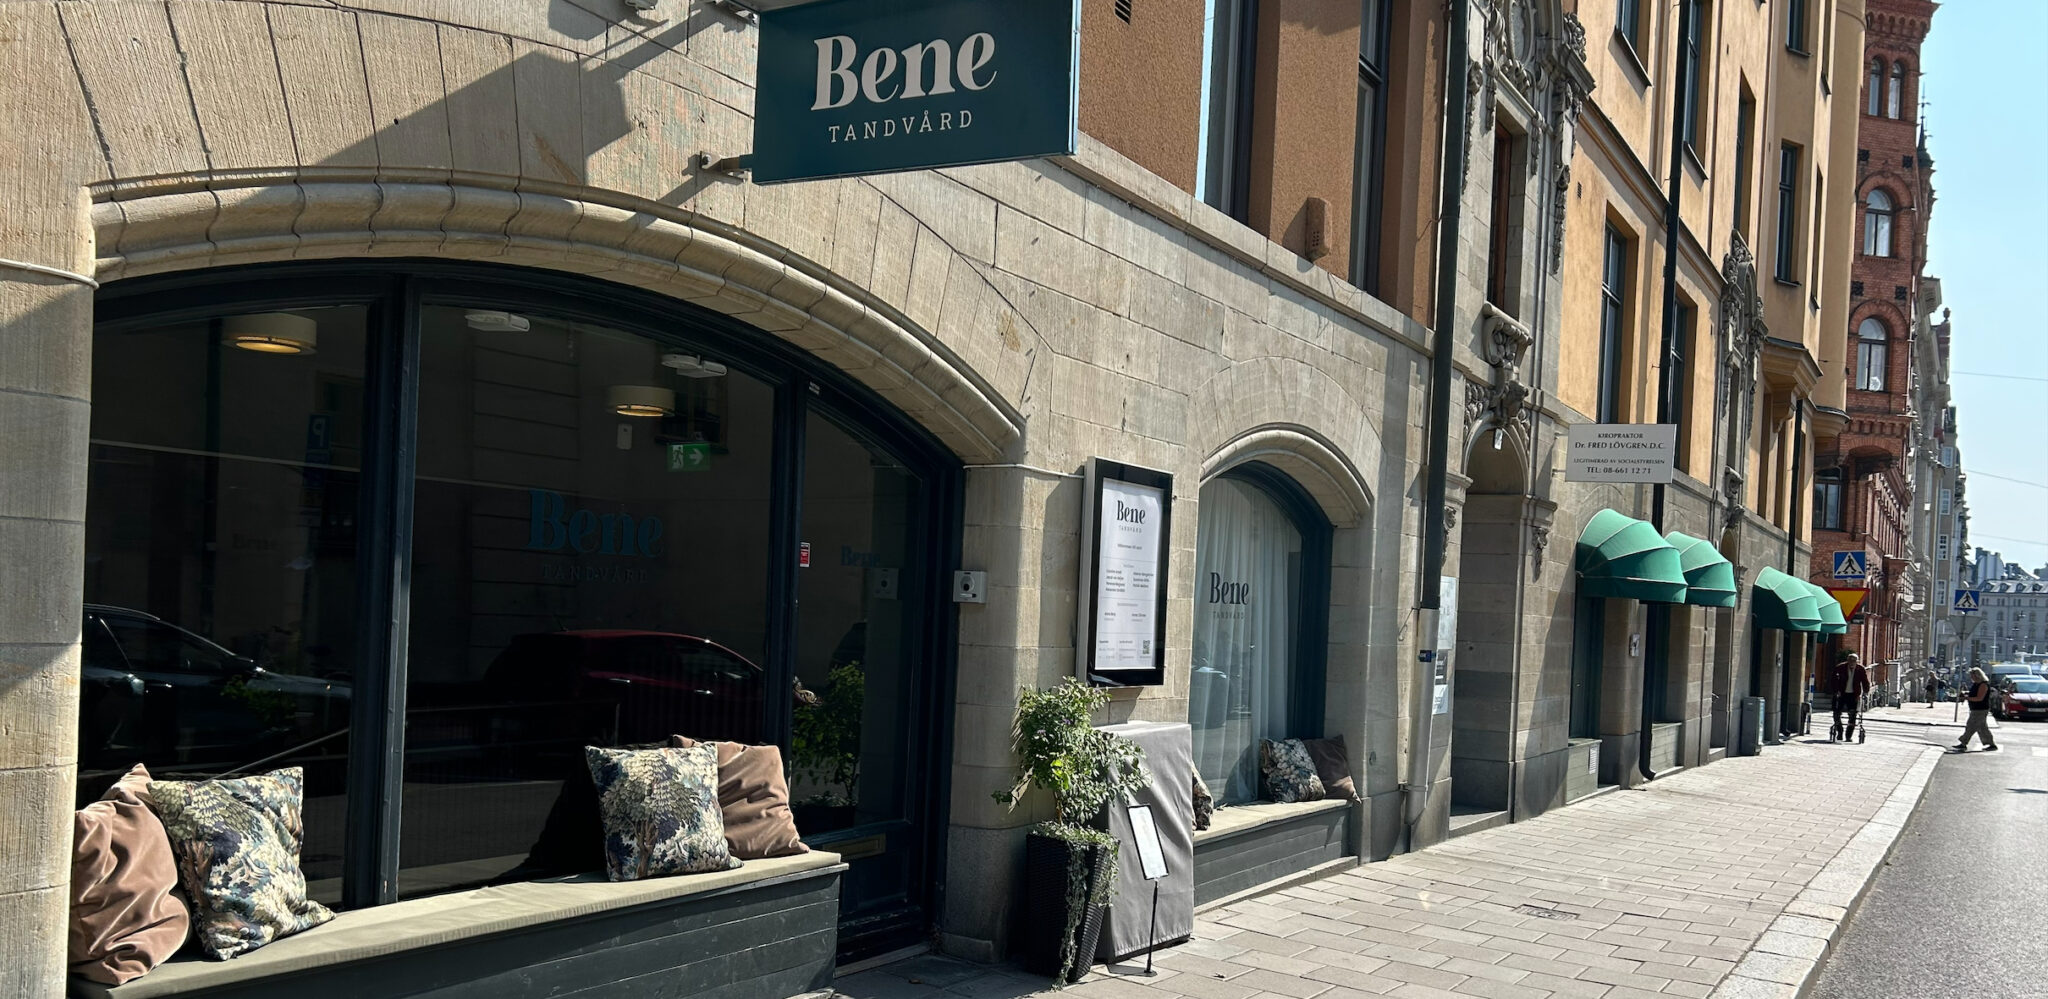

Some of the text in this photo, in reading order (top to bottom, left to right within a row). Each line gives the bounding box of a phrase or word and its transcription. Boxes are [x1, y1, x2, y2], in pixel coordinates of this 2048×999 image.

[811, 32, 998, 110] Bene
[828, 110, 973, 143] TANDVÅRD
[1586, 466, 1602, 474] TEL:
[1603, 466, 1629, 474] 08-661
[525, 488, 665, 560] Bene
[1116, 500, 1146, 525] Bene
[1209, 572, 1249, 605] Bene
